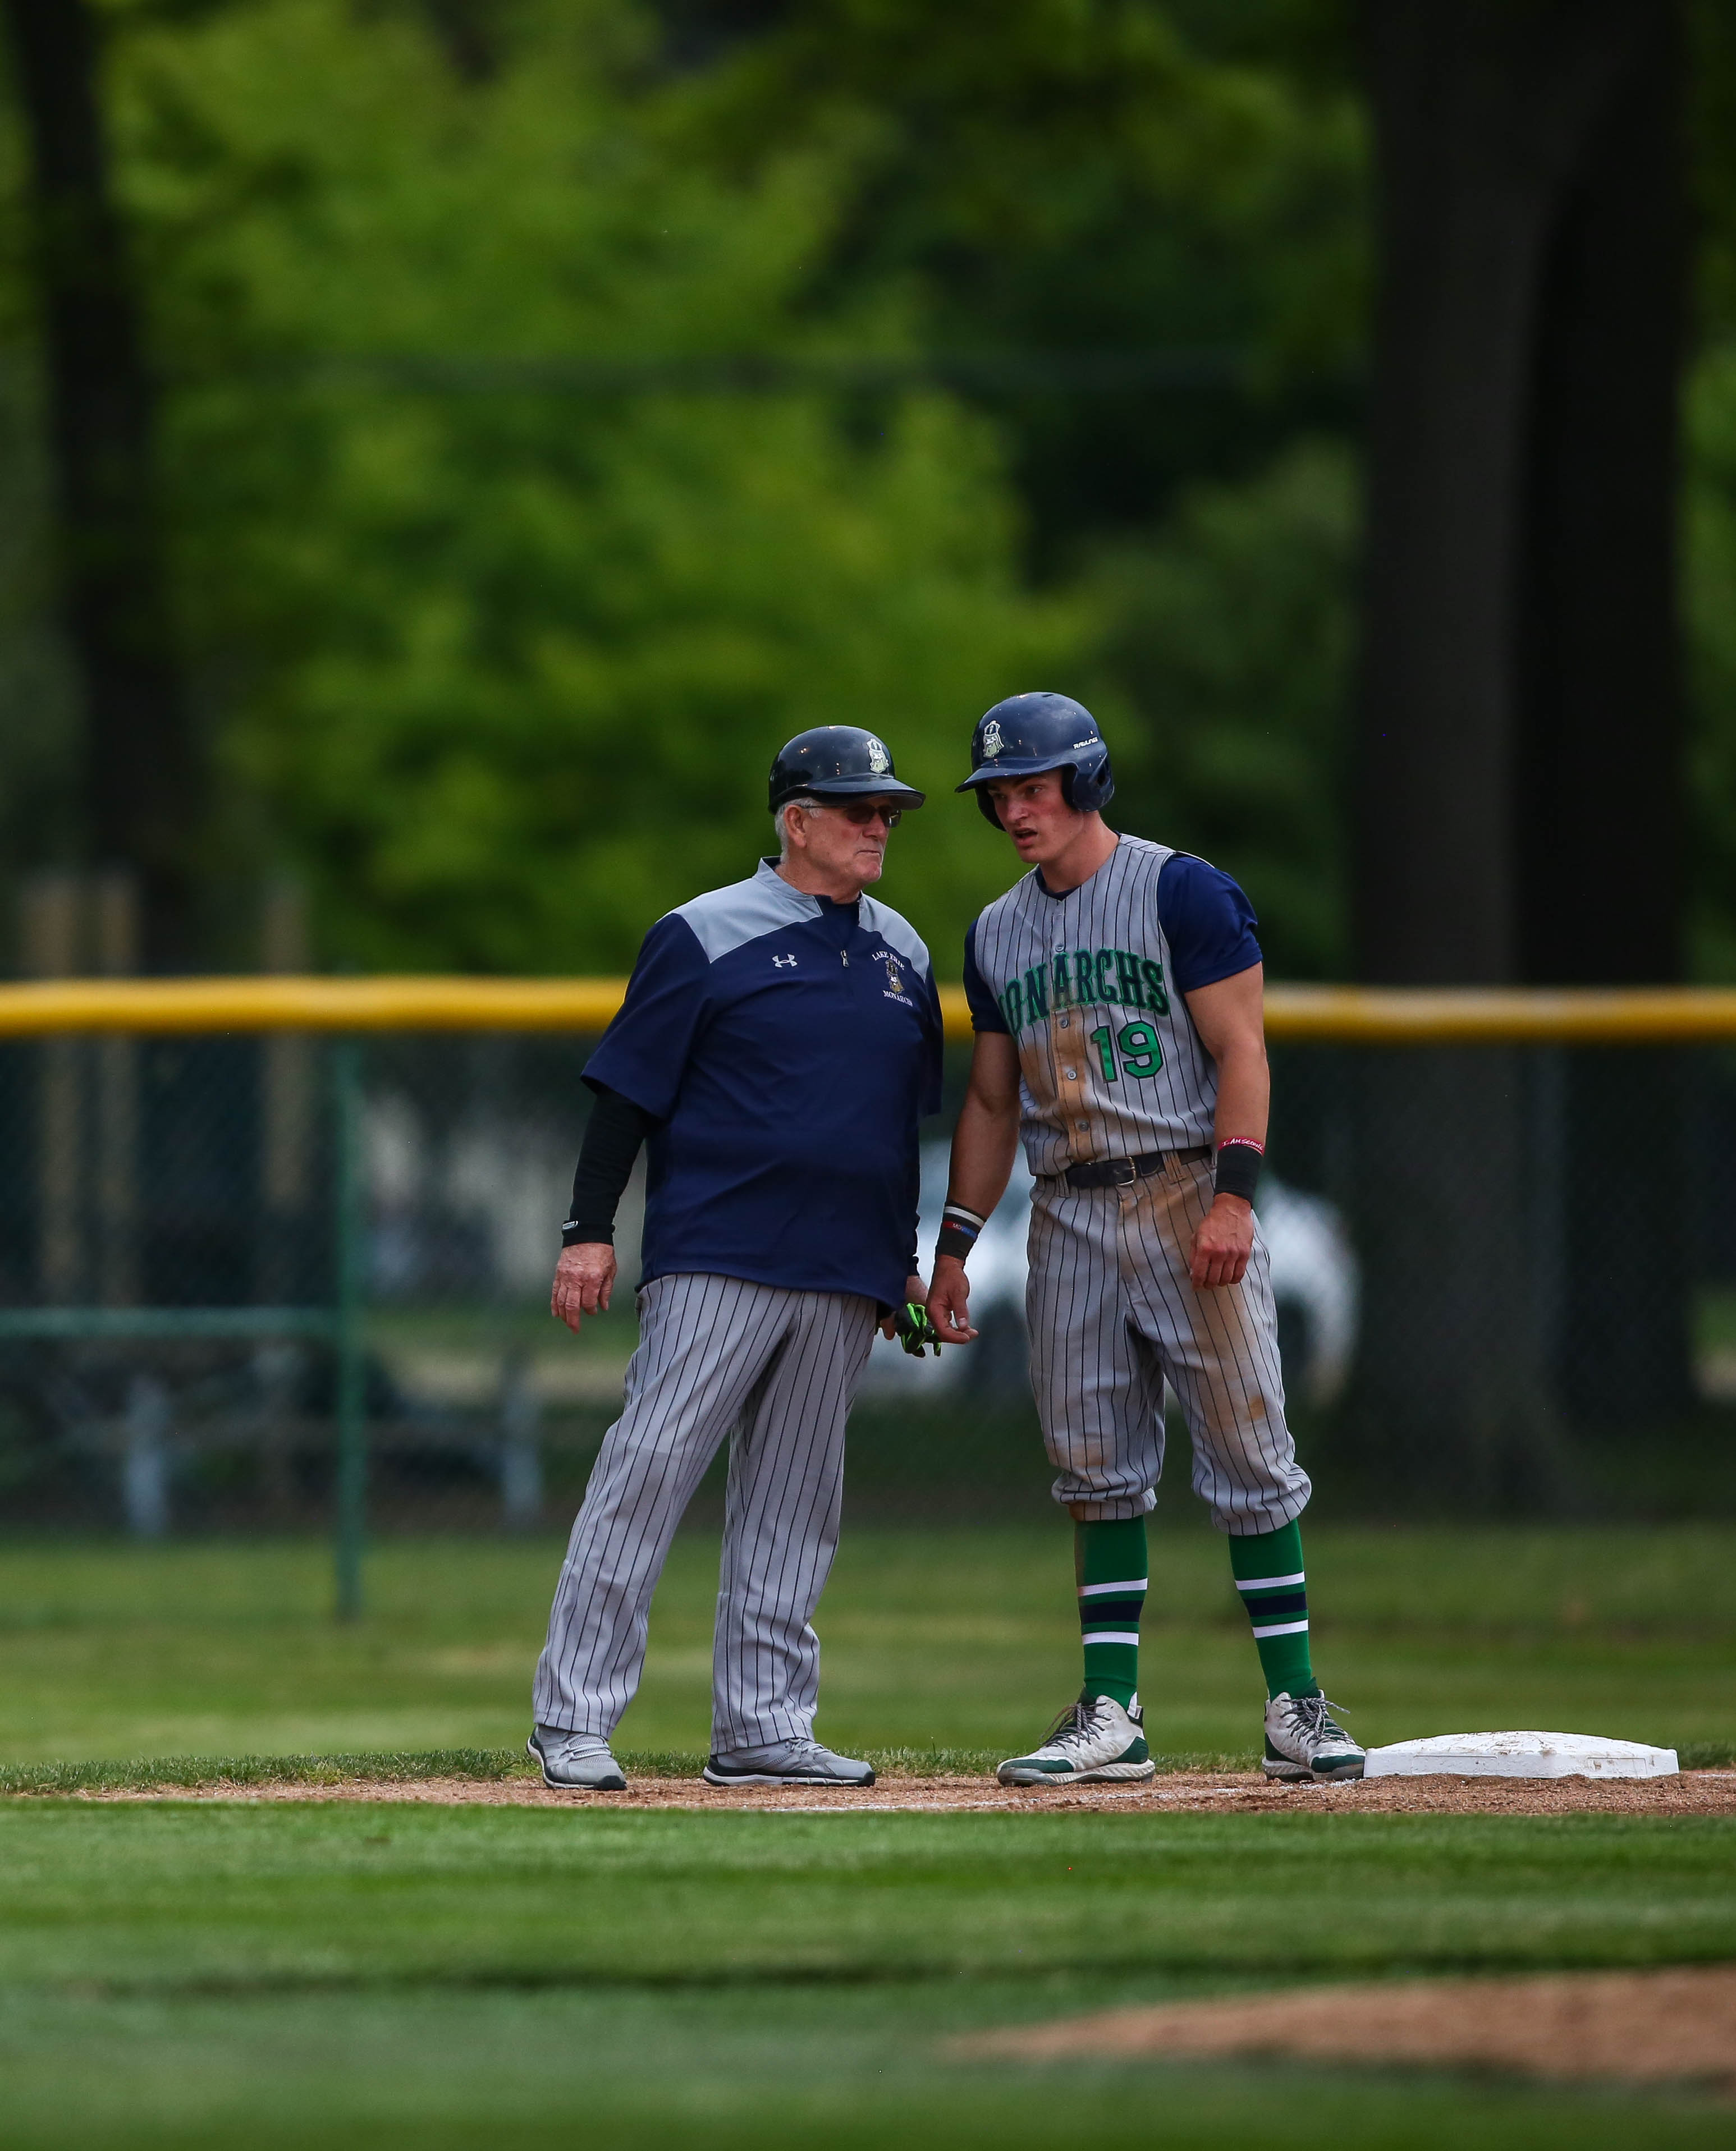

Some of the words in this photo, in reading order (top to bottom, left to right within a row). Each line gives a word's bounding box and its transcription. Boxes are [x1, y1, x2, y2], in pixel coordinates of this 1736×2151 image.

[872, 951, 889, 961] LAKE
[889, 953, 905, 970] ERIE
[883, 990, 913, 1007] MONARCHS
[998, 948, 1170, 1038] ONARCHS
[1090, 1020, 1164, 1084] 19
